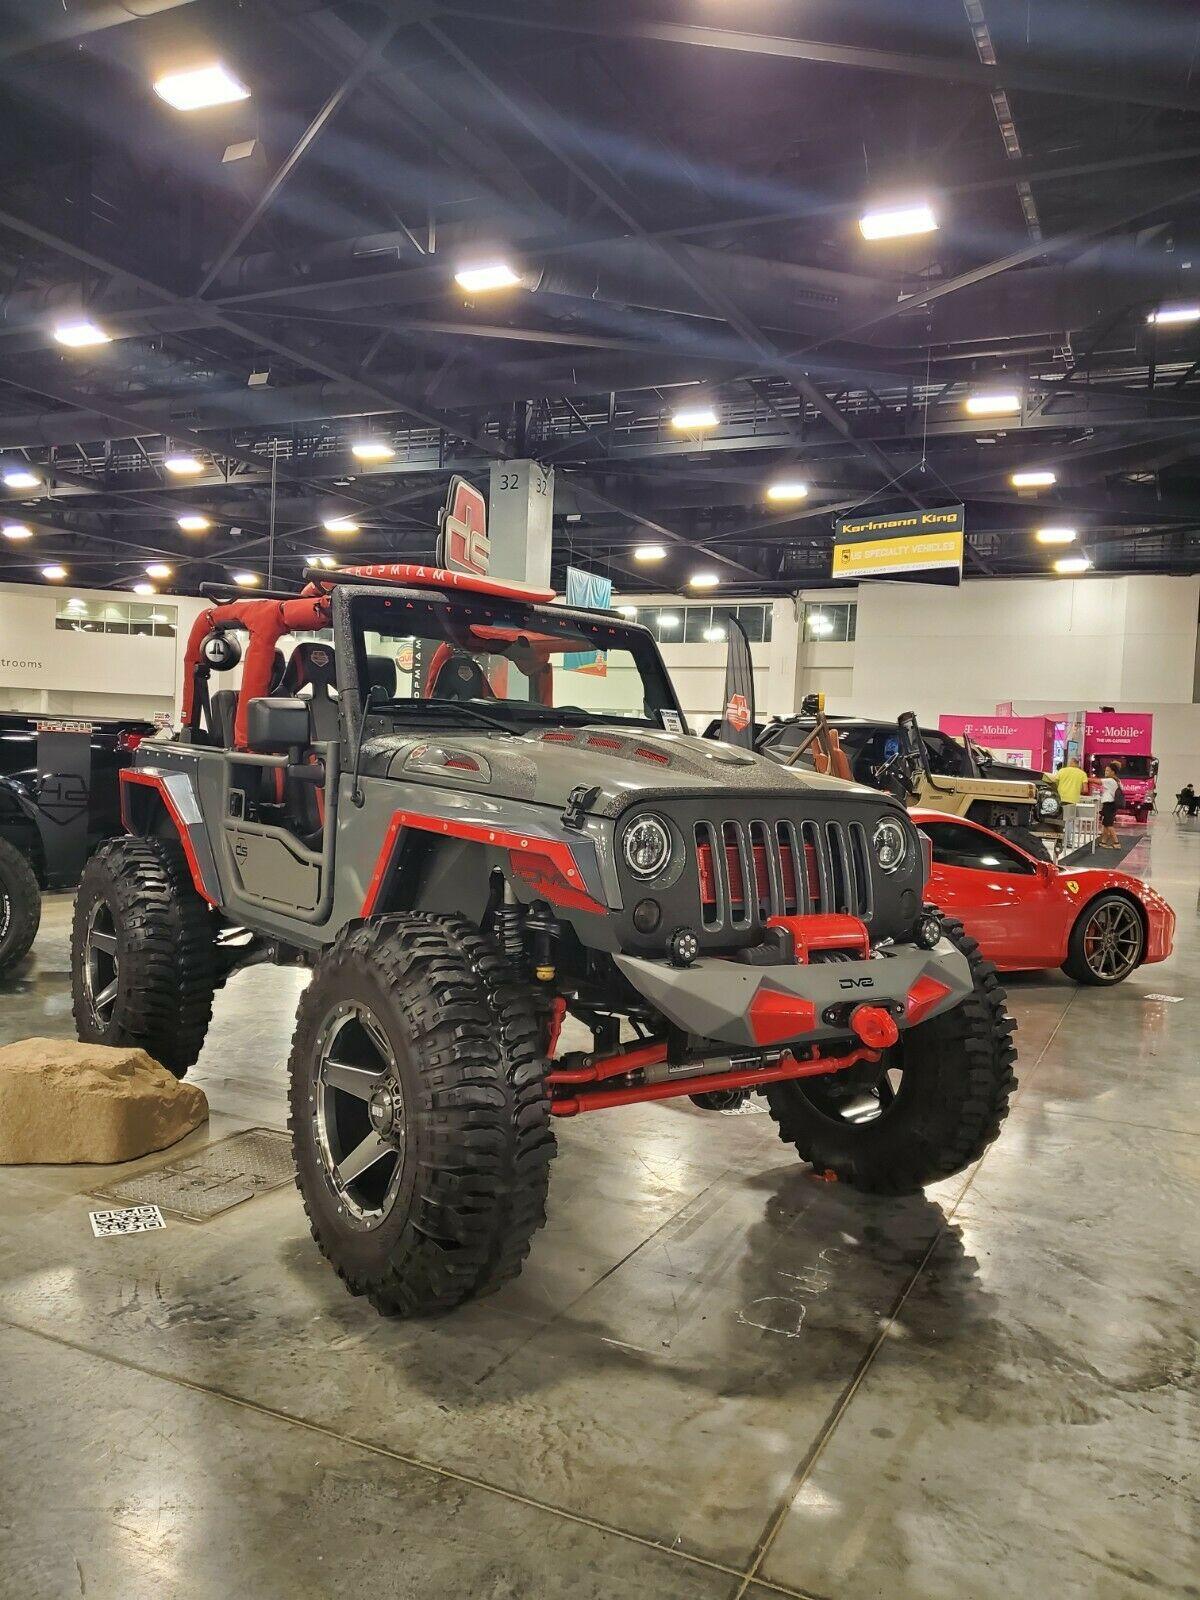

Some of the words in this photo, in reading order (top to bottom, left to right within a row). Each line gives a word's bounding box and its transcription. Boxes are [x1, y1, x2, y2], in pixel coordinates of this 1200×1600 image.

[500, 474, 519, 490] 32
[536, 477, 547, 496] 32
[842, 518, 917, 534] Karlmann
[921, 513, 958, 525] King
[864, 544, 910, 560] SPECIALTY
[911, 541, 955, 555] VEHICLES
[0, 659, 42, 669] trooms
